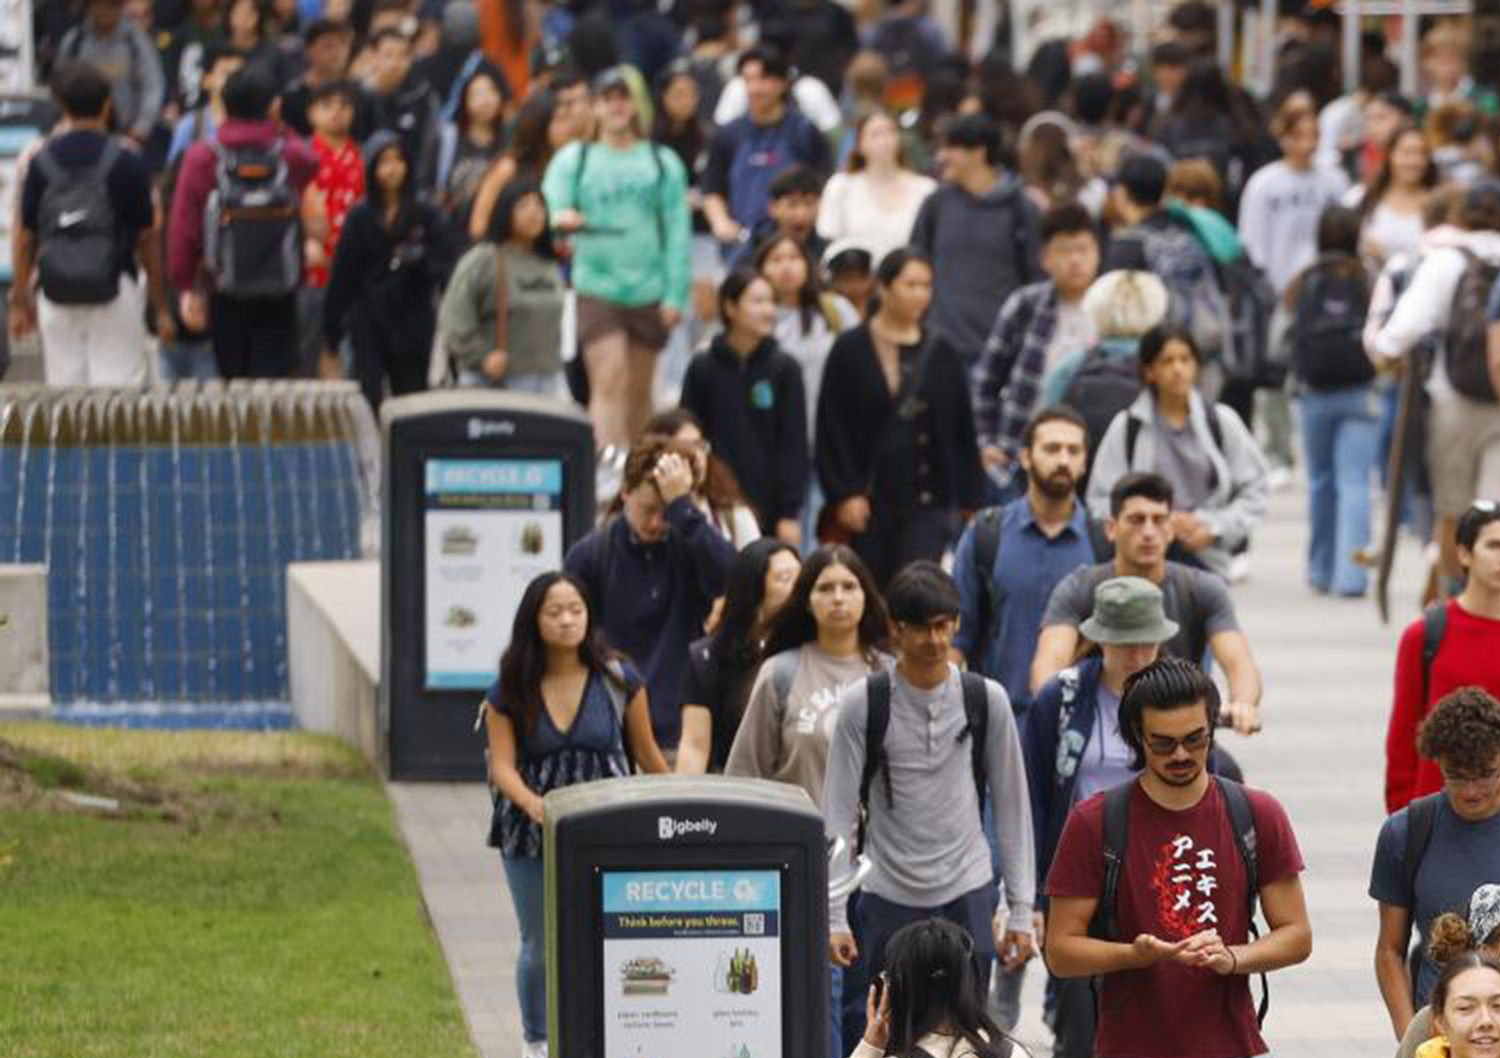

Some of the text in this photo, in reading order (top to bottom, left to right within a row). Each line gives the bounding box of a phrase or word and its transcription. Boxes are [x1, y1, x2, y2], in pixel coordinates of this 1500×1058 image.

[658, 816, 718, 840] Bigbelly
[1172, 835, 1194, 911] アニメ
[626, 880, 726, 901] RECYCLE
[1195, 848, 1218, 934] エキス
[618, 915, 646, 928] Think
[649, 915, 683, 927] before
[684, 916, 705, 929] you
